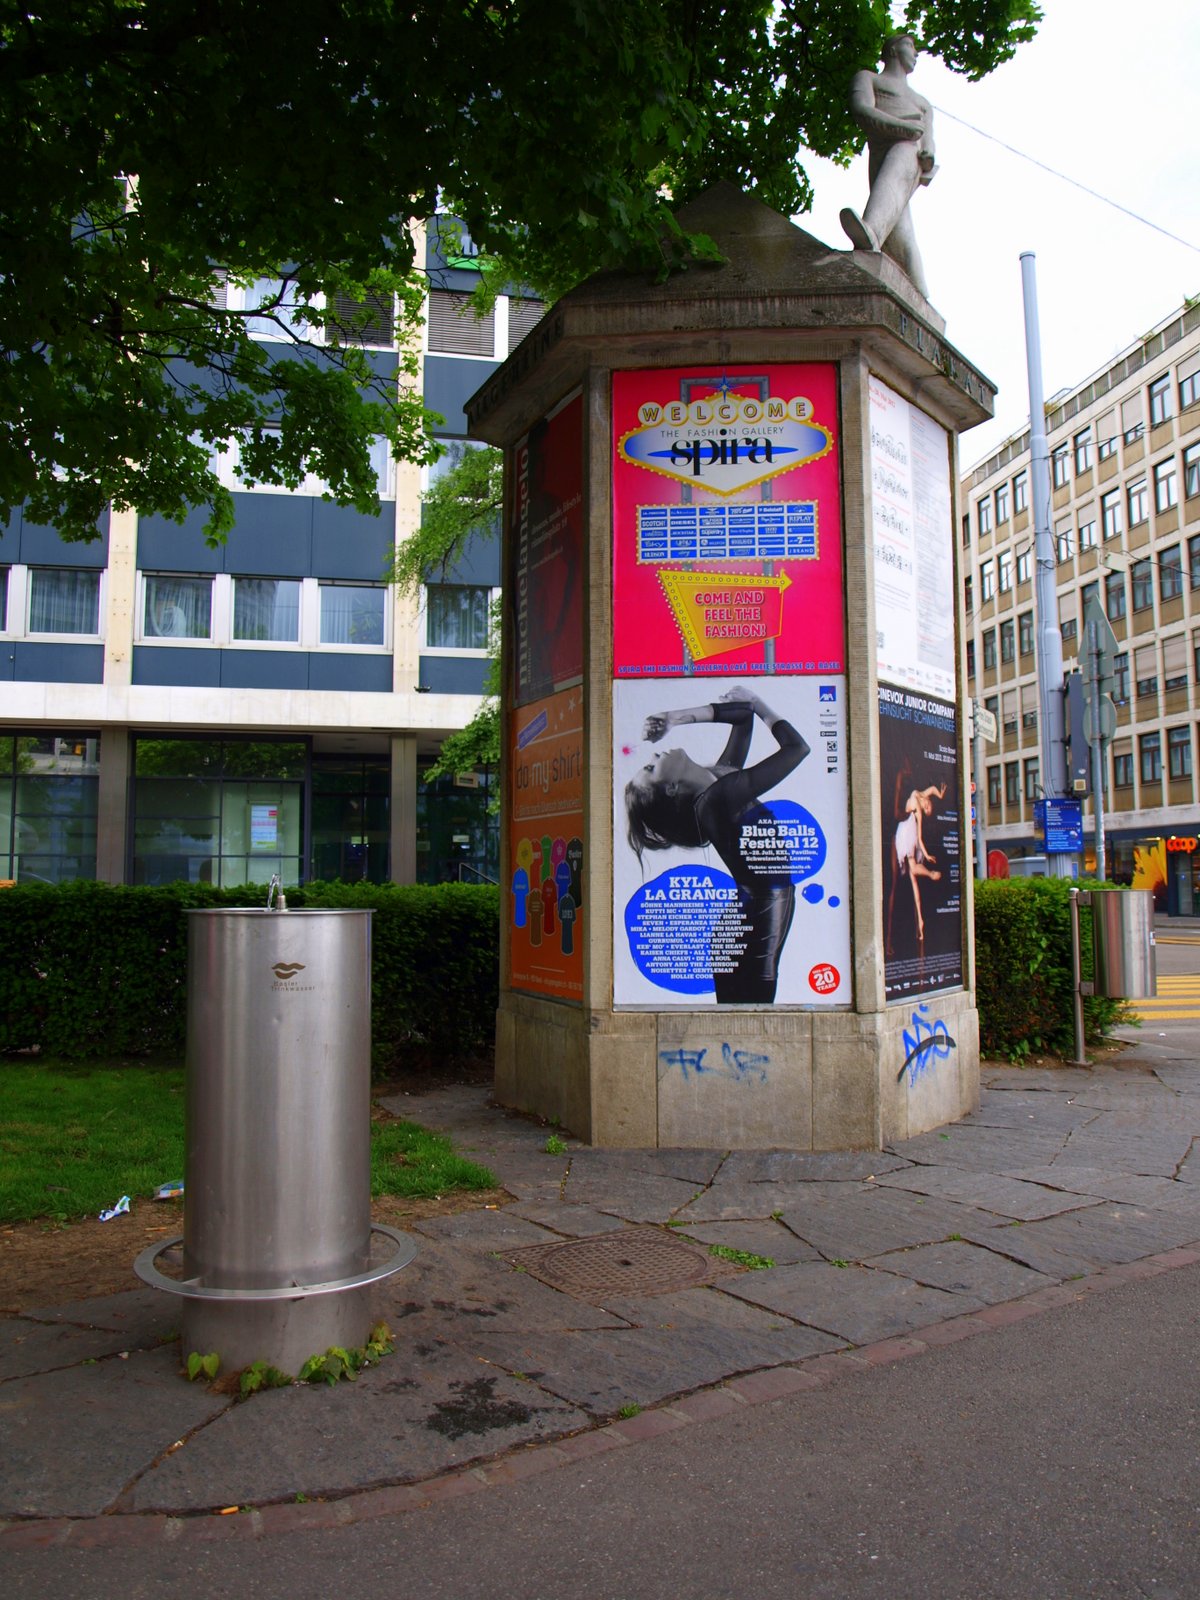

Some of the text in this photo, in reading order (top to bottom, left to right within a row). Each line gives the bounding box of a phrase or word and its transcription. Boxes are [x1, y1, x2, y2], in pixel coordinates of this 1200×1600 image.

[899, 313, 987, 405] PLAKAT
[642, 402, 806, 422] WELCOME
[688, 428, 736, 437] FASHION
[742, 426, 784, 435] GALLERY
[670, 437, 777, 476] spira
[518, 449, 530, 685] michelangelo
[695, 591, 764, 604] COME AND
[705, 607, 761, 621] FEEL THE
[705, 624, 766, 637] FASHION!
[880, 701, 912, 720] EHNSUCHT
[905, 695, 927, 711] JUNIOR
[928, 702, 955, 719] COMPANY
[516, 746, 581, 793] do my shirt
[742, 825, 815, 836] Blue Balls
[739, 837, 818, 848] Festival 12
[1167, 837, 1196, 853] coop
[669, 877, 713, 888] KYLA
[645, 889, 738, 900] LA GRANGE
[814, 971, 834, 987] 20
